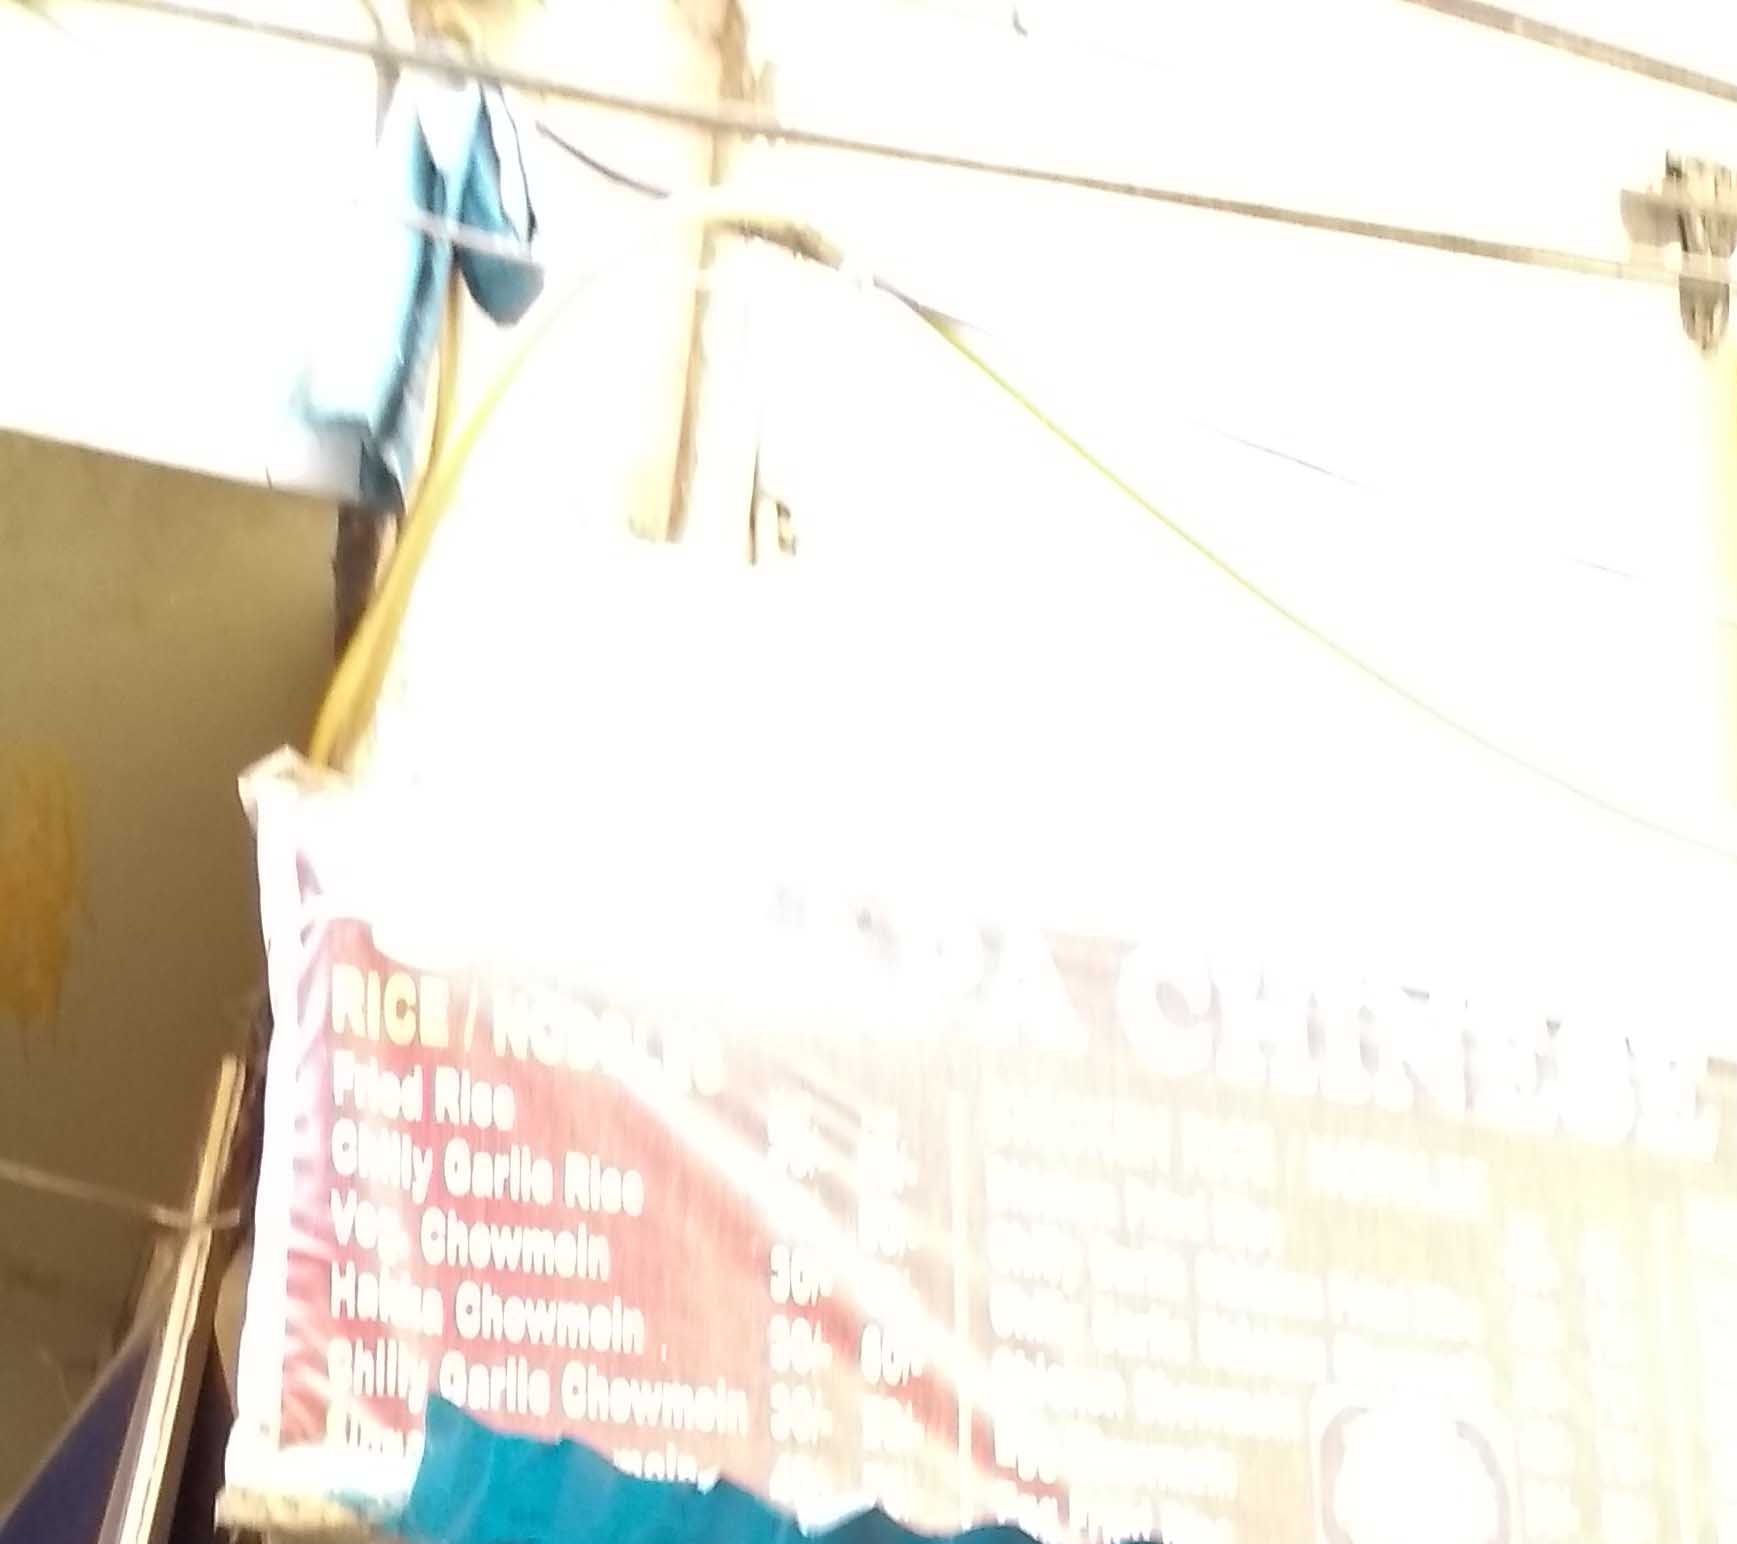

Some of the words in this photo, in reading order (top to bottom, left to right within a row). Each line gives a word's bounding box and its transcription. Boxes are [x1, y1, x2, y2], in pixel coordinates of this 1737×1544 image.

[330, 963, 449, 1047] RICE
[332, 1050, 423, 1121] Fried
[434, 1066, 515, 1130] Rice
[564, 1152, 645, 1217] Rice
[421, 1207, 611, 1281] Chowmein
[455, 1279, 646, 1355] Chowmein
[562, 1361, 749, 1438] Chowmein
